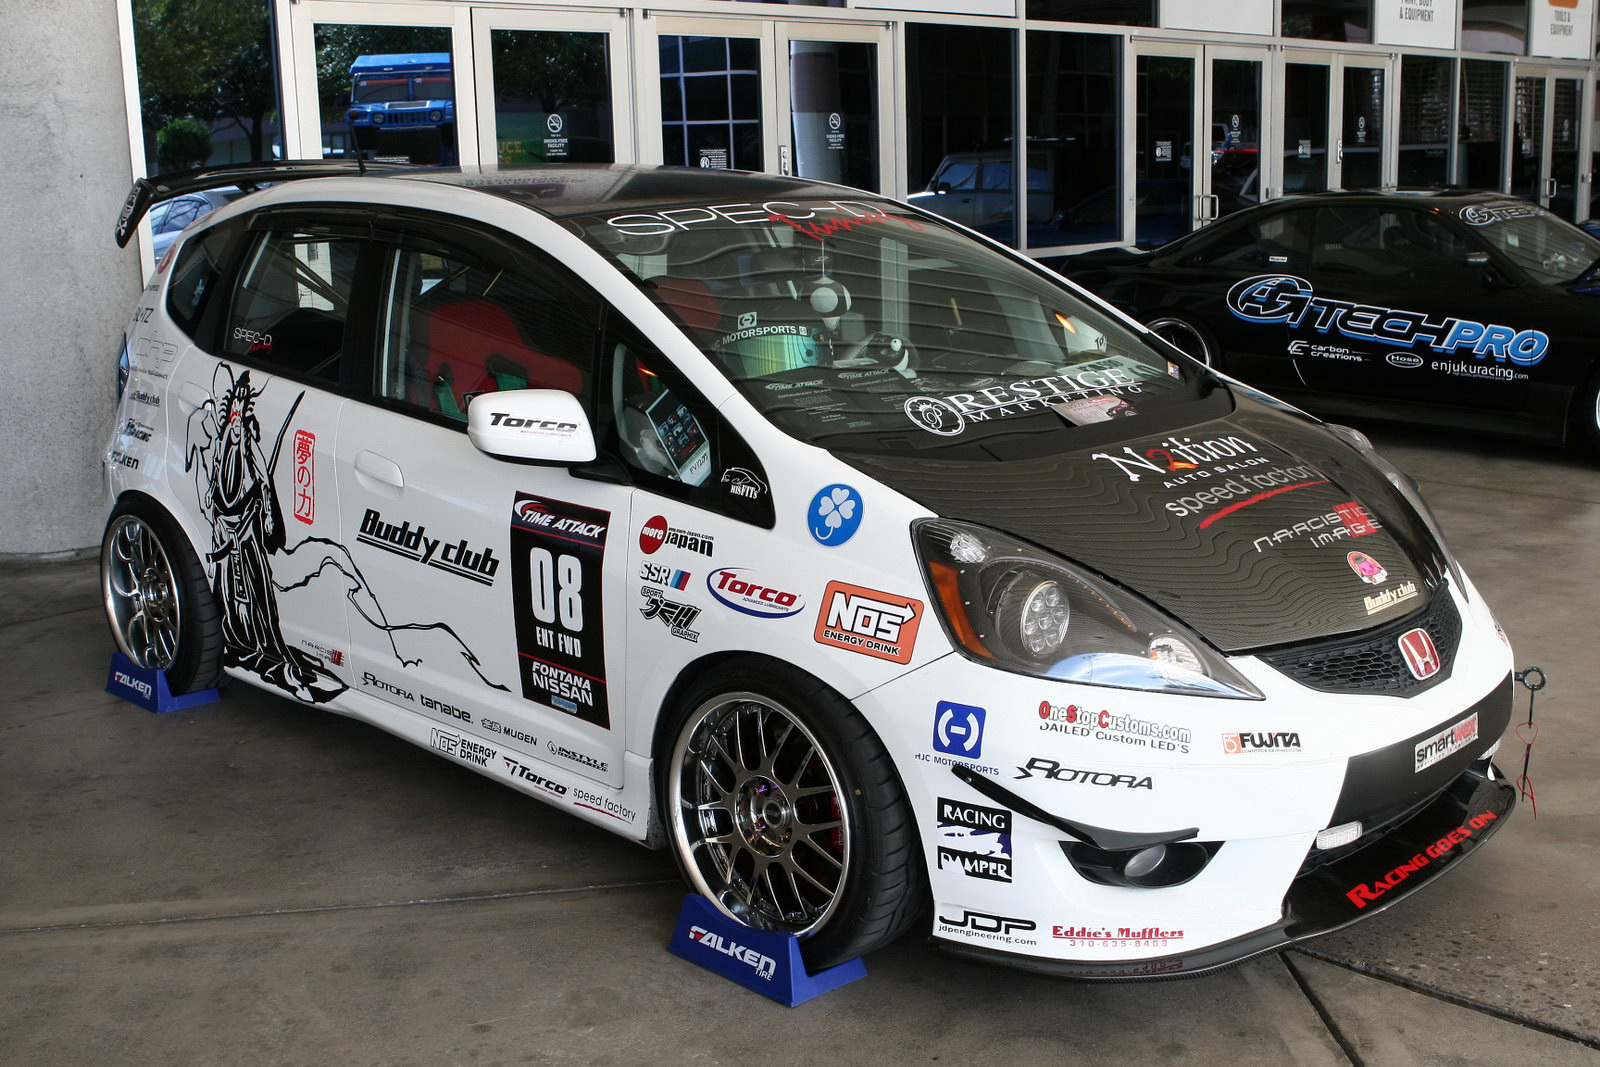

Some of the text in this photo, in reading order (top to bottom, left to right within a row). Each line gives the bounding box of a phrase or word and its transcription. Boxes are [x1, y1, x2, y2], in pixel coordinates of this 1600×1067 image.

[723, 325, 797, 345] MOTORSPORTS
[1310, 344, 1350, 354] carbon
[1310, 350, 1363, 362] creations
[967, 385, 1142, 423] MARKETING
[490, 412, 578, 433] Torco
[1163, 456, 1270, 489] AUTO SALON
[1165, 464, 1317, 517] speed factor
[522, 509, 606, 538] TIME ATTACK
[642, 527, 664, 540] more
[360, 508, 500, 577] Buddy club
[665, 531, 714, 557] japan
[639, 560, 672, 585] SSR
[530, 546, 584, 632] 08
[717, 570, 798, 607] Torco
[826, 591, 914, 643] NOS
[536, 626, 582, 658] ENT FWD
[823, 629, 900, 656] ENERGY DRINK
[114, 671, 152, 696] FALKEN
[532, 661, 592, 692] FONTANA
[532, 672, 594, 707] NISSAN
[1038, 700, 1192, 744] OneStopCustoms.com
[431, 727, 497, 759] NOS ENERGY
[503, 726, 538, 746] MUGEN
[1095, 727, 1147, 747] Custom
[1239, 732, 1302, 748] FUJITA
[460, 750, 488, 767] DRINK
[518, 764, 568, 796] Torco
[573, 787, 603, 807] speed
[604, 798, 636, 822] factory
[943, 803, 1006, 830] RACING
[1345, 809, 1499, 910] RACING GOES ON
[937, 923, 1037, 947] jdpengineering.com
[938, 910, 1037, 935] JDP
[1052, 925, 1184, 940] Eddie's Mufflers
[688, 925, 777, 977] FALKEN
[755, 967, 773, 981] TIRE
